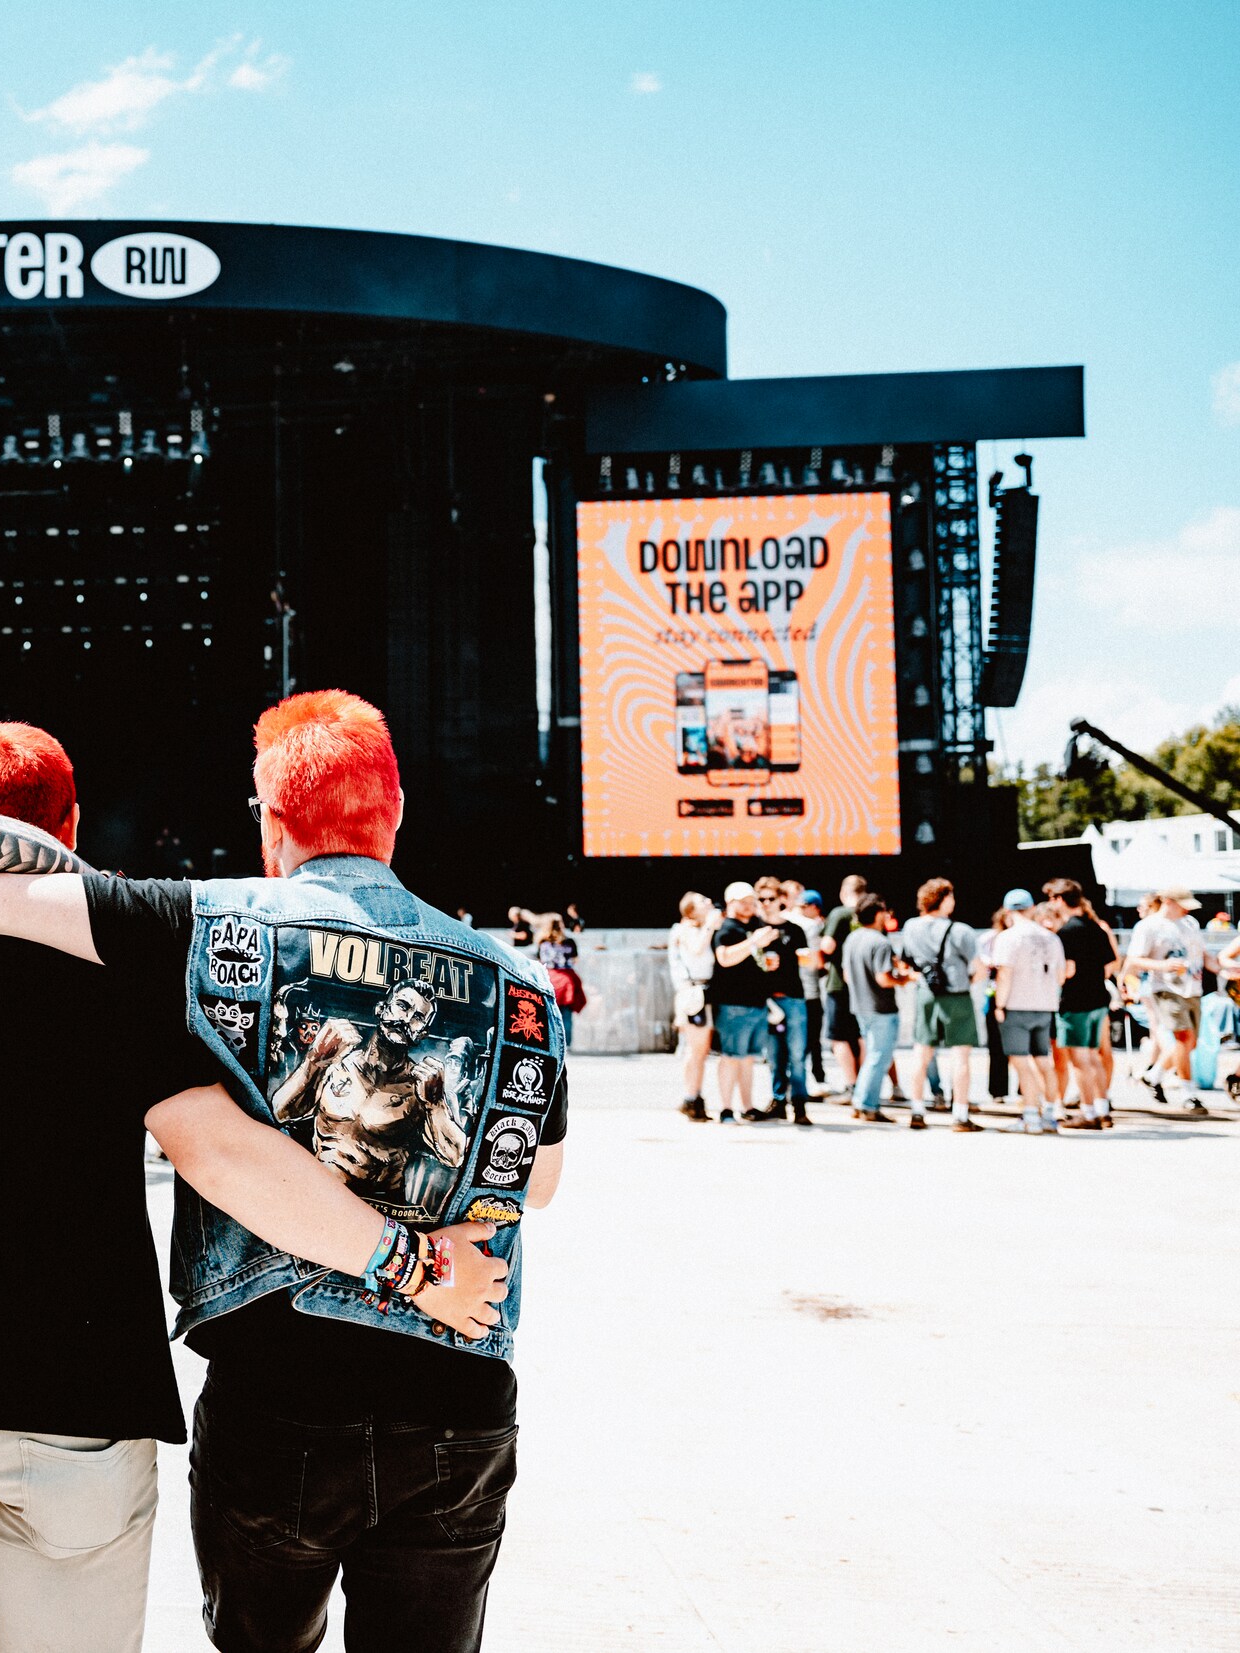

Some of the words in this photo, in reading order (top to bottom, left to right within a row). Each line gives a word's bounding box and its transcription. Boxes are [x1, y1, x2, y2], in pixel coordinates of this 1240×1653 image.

[125, 246, 187, 286] RW
[212, 922, 258, 951] PAPA
[210, 958, 259, 986] ROACH
[309, 930, 473, 1004] VOLBEAT
[502, 1088, 517, 1100] RISE
[515, 1093, 547, 1105] AGAINST
[391, 1209, 420, 1217] BOOGIE
